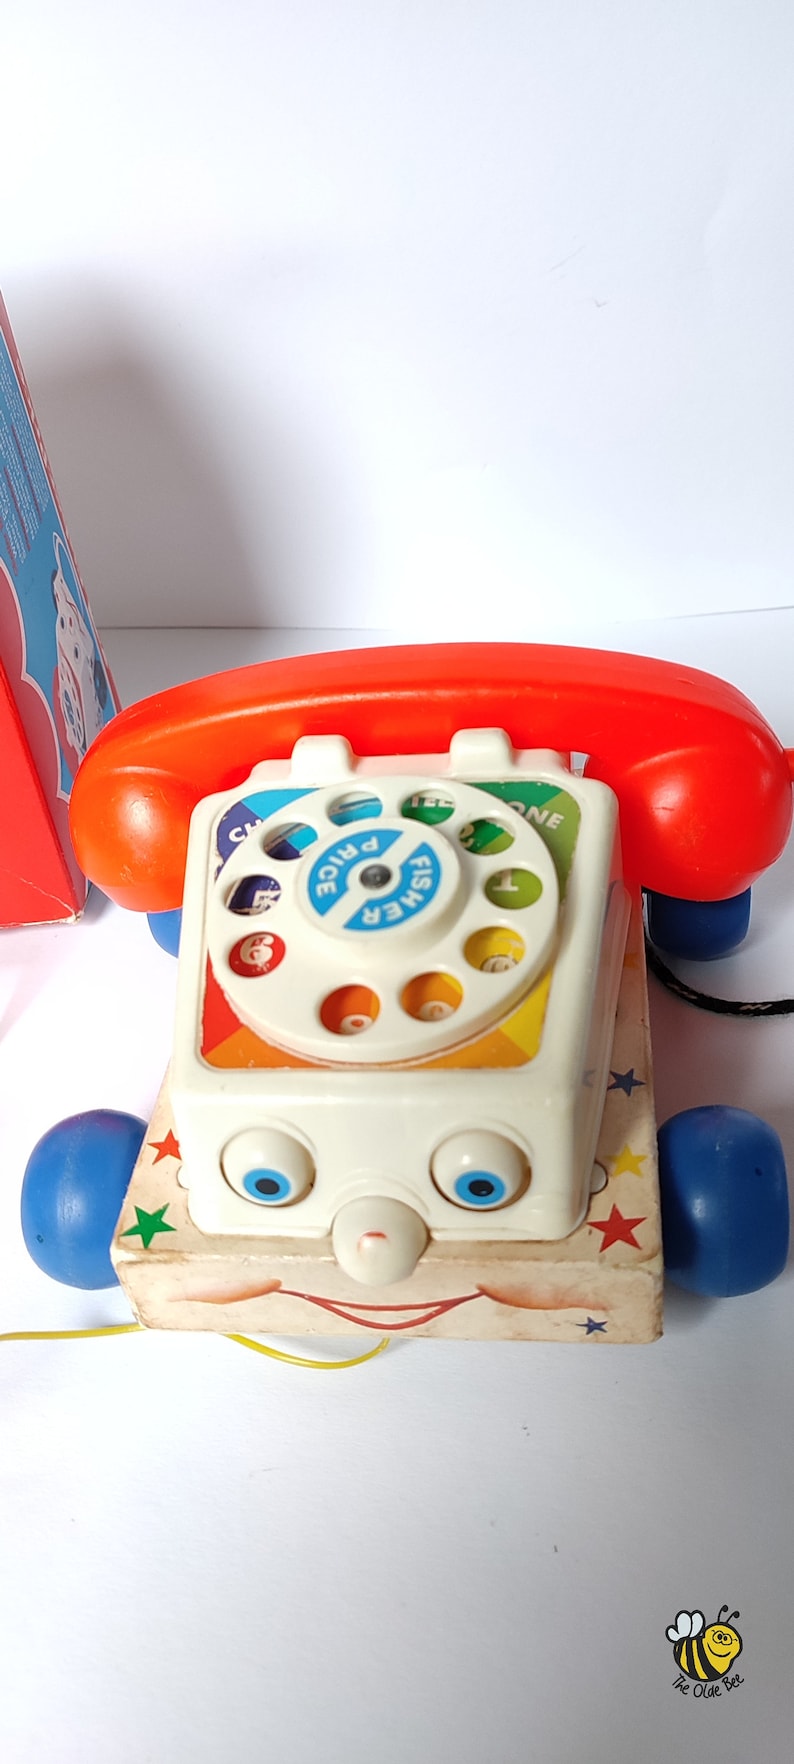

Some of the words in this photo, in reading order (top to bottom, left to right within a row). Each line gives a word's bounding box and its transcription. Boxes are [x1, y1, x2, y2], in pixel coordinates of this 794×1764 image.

[315, 835, 379, 898] PRICE
[360, 854, 433, 927] FISHER
[239, 932, 275, 967] 6
